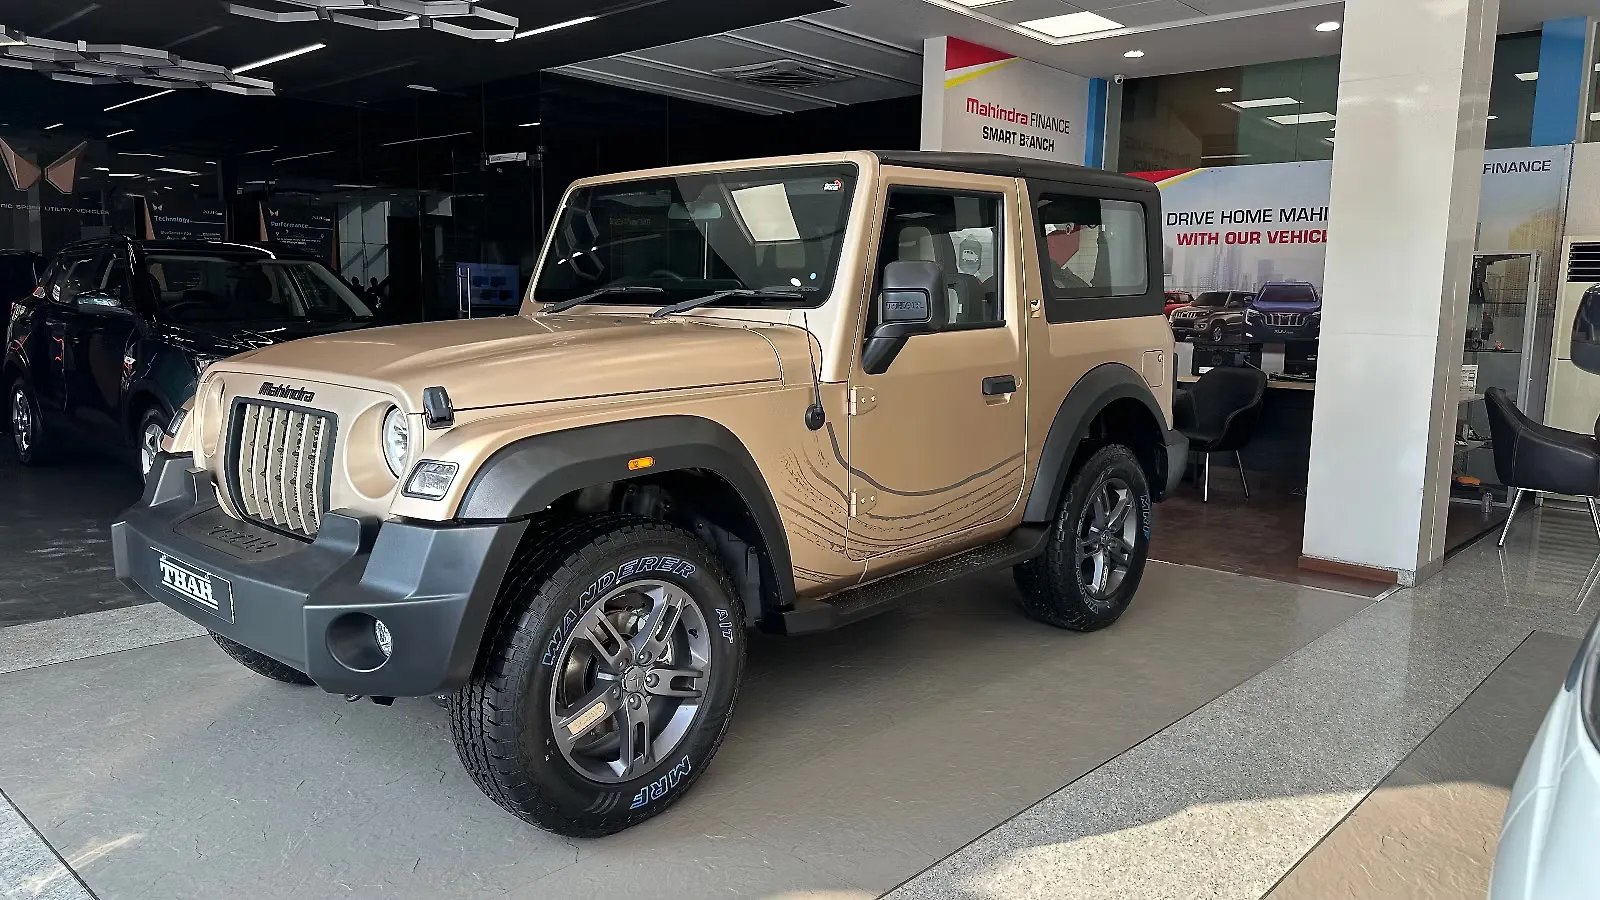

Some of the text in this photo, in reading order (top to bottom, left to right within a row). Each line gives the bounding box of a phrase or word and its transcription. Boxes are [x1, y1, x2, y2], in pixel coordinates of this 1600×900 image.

[966, 97, 1070, 135] Mahindra FINANCE
[982, 126, 1018, 145] SMART
[1483, 160, 1551, 175] FINANCE
[154, 215, 190, 224] Technology
[1166, 206, 1329, 226] DRIVE HOME MAHI
[1176, 232, 1219, 246] WITH
[1224, 231, 1261, 245] OUR
[258, 381, 315, 402] Mahindra
[159, 557, 218, 600] THAR
[542, 556, 696, 666] WANDERER
[630, 754, 692, 809] MRF
